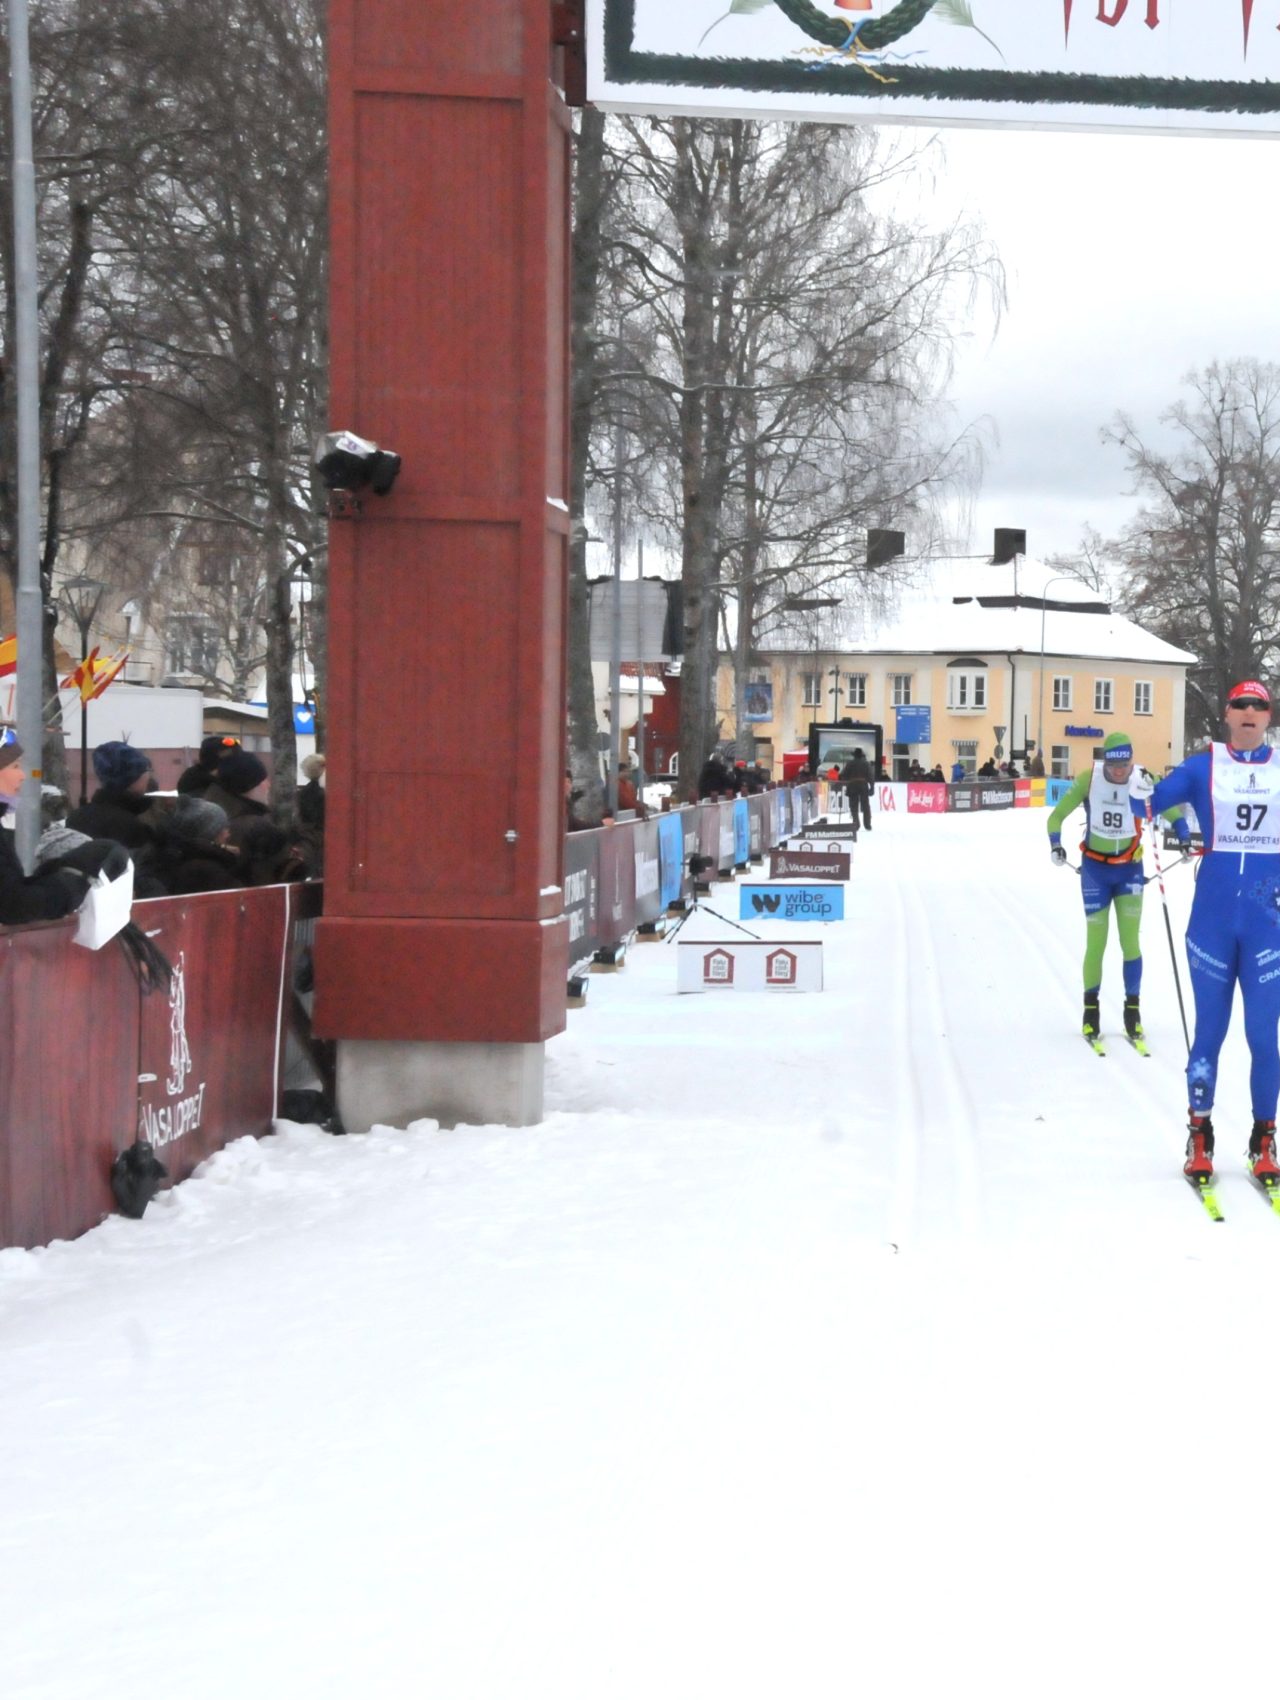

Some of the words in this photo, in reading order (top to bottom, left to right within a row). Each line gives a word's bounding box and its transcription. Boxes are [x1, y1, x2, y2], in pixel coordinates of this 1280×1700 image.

[879, 785, 896, 812] ICA
[1103, 811, 1123, 828] 89
[1236, 804, 1268, 831] 97
[1167, 837, 1180, 845] FM
[1218, 834, 1270, 845] VASALOPPET
[788, 863, 841, 873] VASALOPPET
[785, 890, 824, 903] wibe
[785, 903, 832, 917] group
[142, 1082, 206, 1150] VASALOPPET
